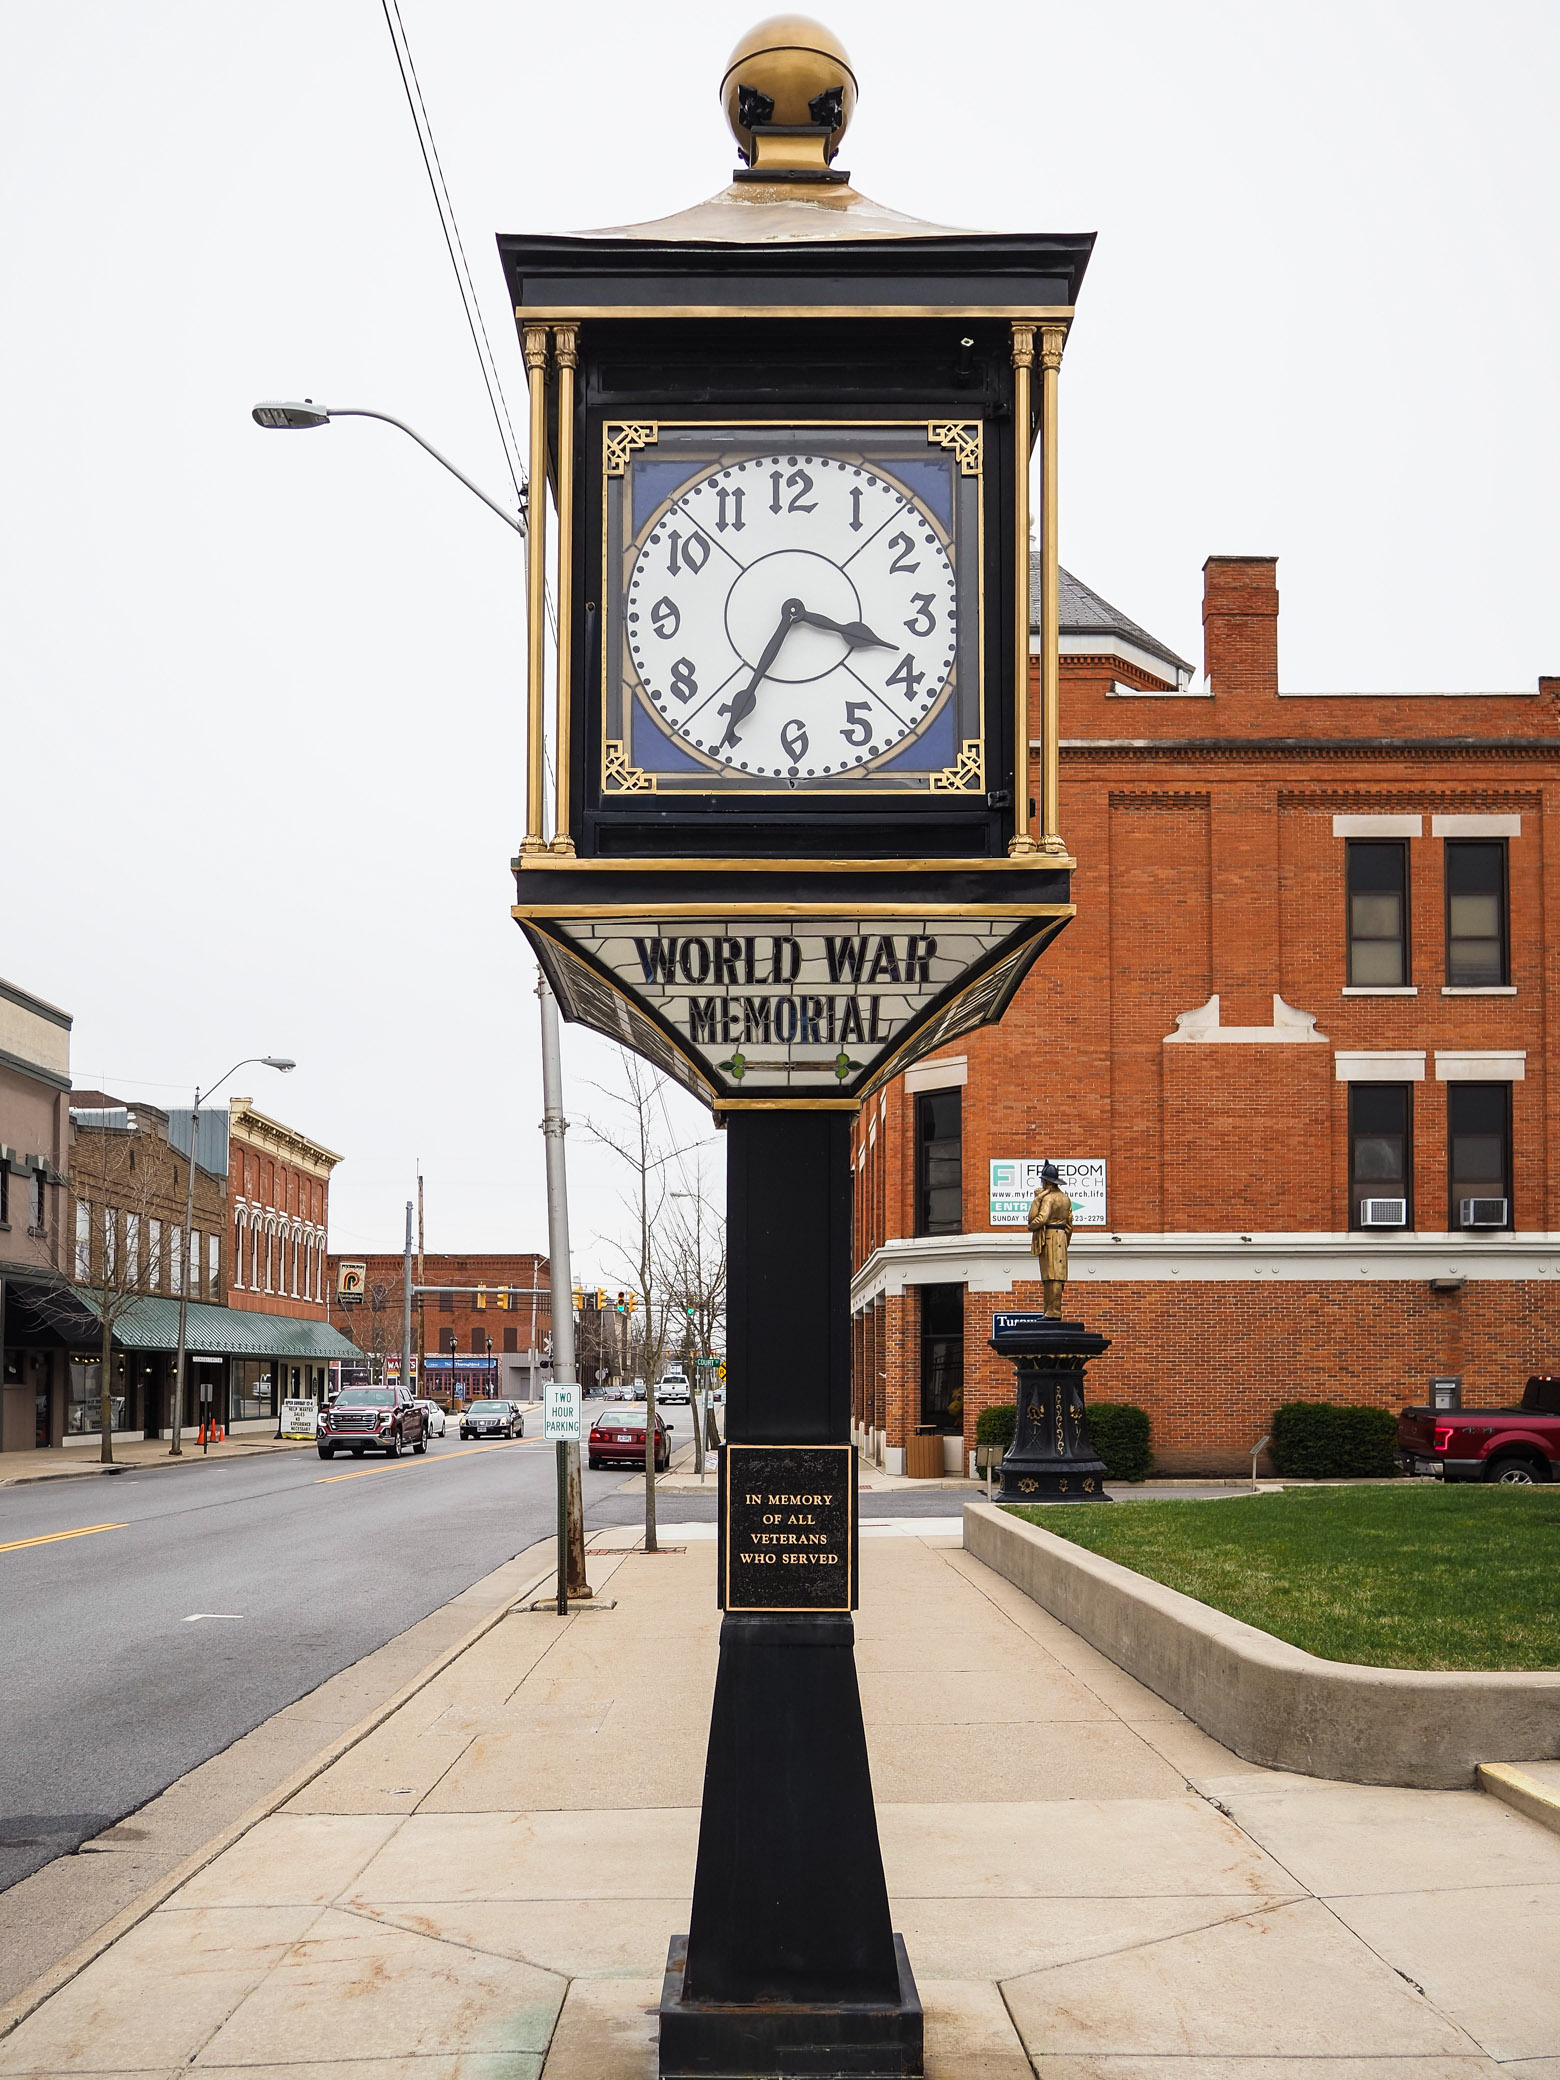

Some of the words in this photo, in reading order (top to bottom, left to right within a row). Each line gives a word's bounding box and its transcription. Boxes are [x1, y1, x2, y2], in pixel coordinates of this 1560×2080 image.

[715, 487, 746, 533] 11
[769, 469, 818, 514] 12
[849, 486, 863, 532] 1
[667, 530, 710, 577] 10
[888, 531, 921, 575] 2
[651, 596, 681, 640] 9
[903, 592, 936, 637] 3
[670, 656, 698, 704] 8
[885, 653, 926, 701] 4
[781, 719, 809, 765] 6
[840, 701, 872, 746] 5
[632, 937, 801, 984] WORLD
[825, 937, 937, 983] WAR
[689, 996, 892, 1044] MEMORIAL
[1027, 1165, 1103, 1176] FREDOM
[1027, 1178, 1104, 1187] CRCH
[995, 1202, 1029, 1211] ENTR
[697, 1359, 715, 1367] COURT
[551, 1406, 574, 1418] HOUR
[555, 1392, 572, 1403] TWO
[546, 1421, 579, 1432] PARKING
[745, 1494, 762, 1505] IN
[768, 1494, 833, 1505] MEMORY
[762, 1514, 782, 1525] OF
[787, 1514, 816, 1525] ALL
[739, 1553, 777, 1564] WHO
[782, 1553, 839, 1565] SERVED
[750, 1533, 828, 1545] VETERANS
